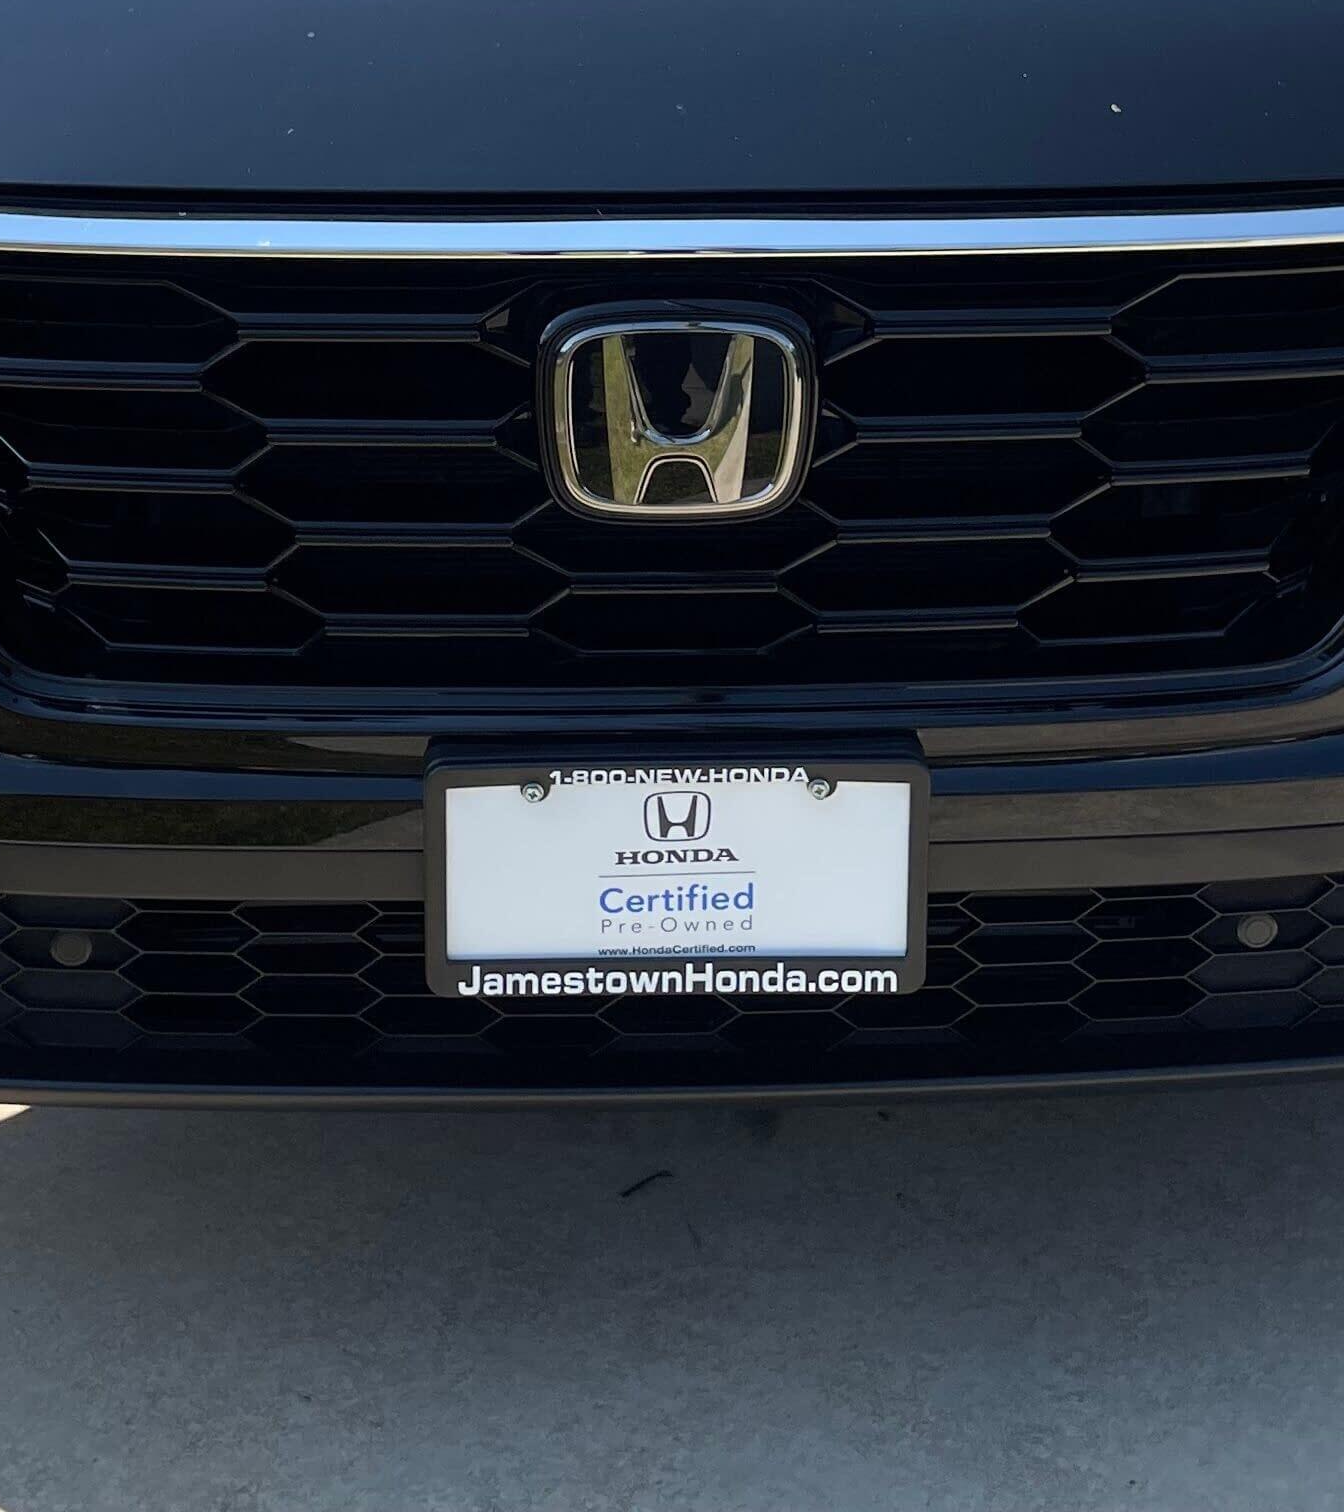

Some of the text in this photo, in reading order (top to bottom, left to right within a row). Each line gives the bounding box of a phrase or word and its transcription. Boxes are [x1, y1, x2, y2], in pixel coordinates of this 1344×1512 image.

[549, 767, 810, 786] 1-800-NEW-HONDA
[614, 848, 739, 865] HONDA
[599, 882, 754, 914] Certified
[601, 915, 753, 934] Pre-Owned
[598, 944, 756, 956] www.HondaCertified.com
[458, 962, 897, 996] JamestownHonda.com
